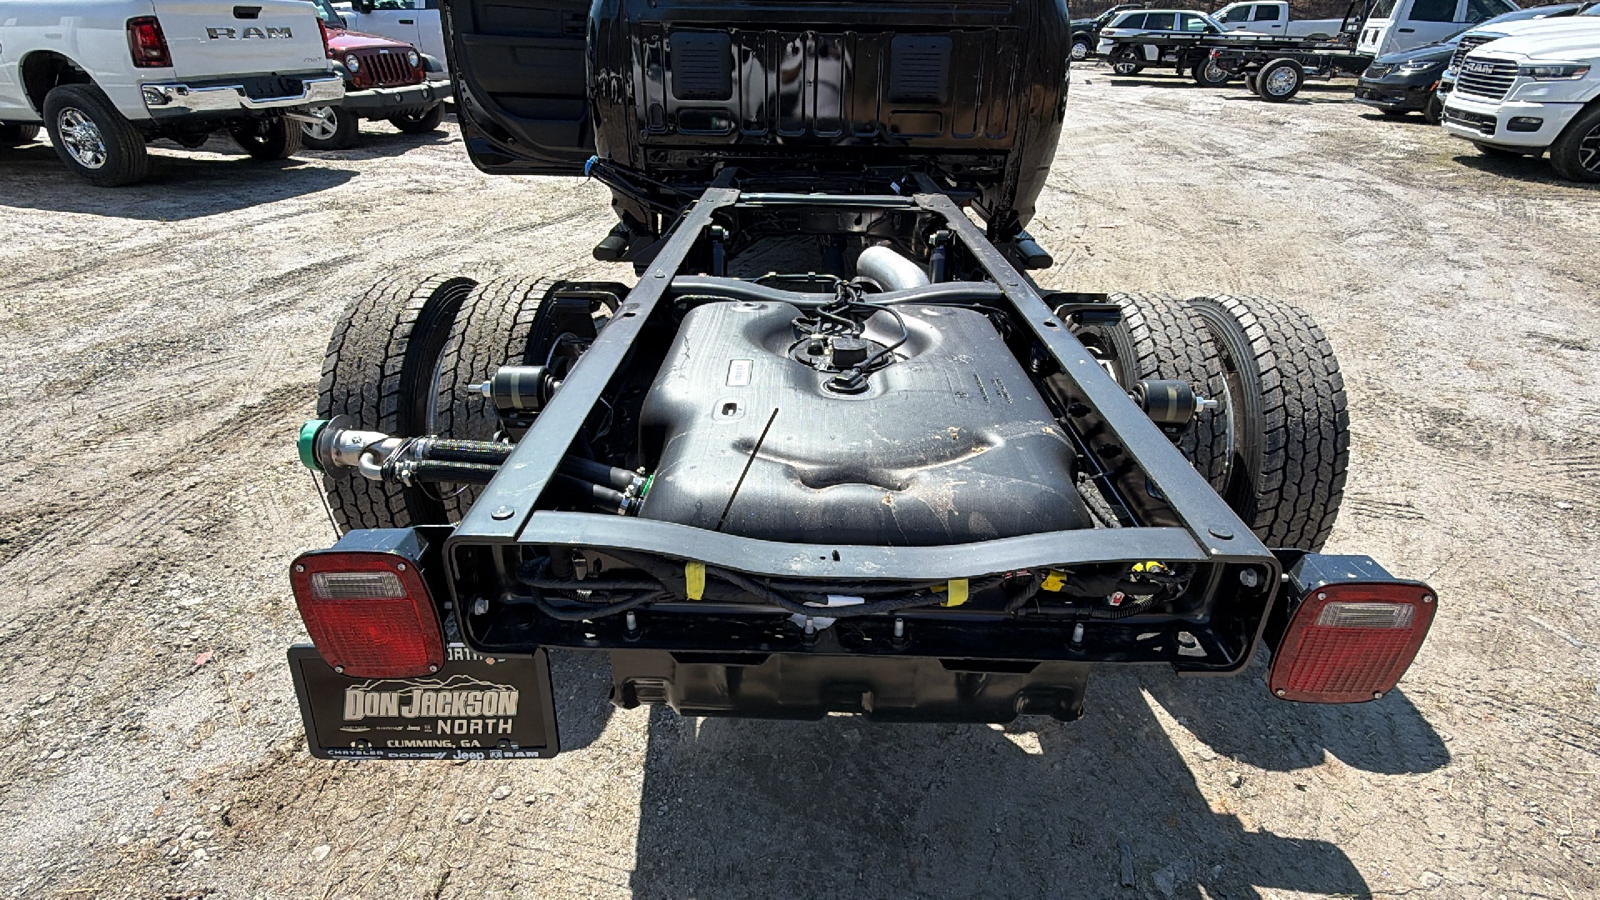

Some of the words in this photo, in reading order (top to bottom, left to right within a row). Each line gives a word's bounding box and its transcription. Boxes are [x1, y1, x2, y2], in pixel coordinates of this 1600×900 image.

[205, 26, 293, 40] RAM
[1464, 62, 1494, 74] RAM
[344, 689, 399, 720] DON
[401, 688, 518, 718] JACKSON
[437, 719, 513, 734] NORTH
[386, 739, 456, 748] CUMMING,
[460, 739, 481, 748] GA
[453, 750, 485, 760] Jeep
